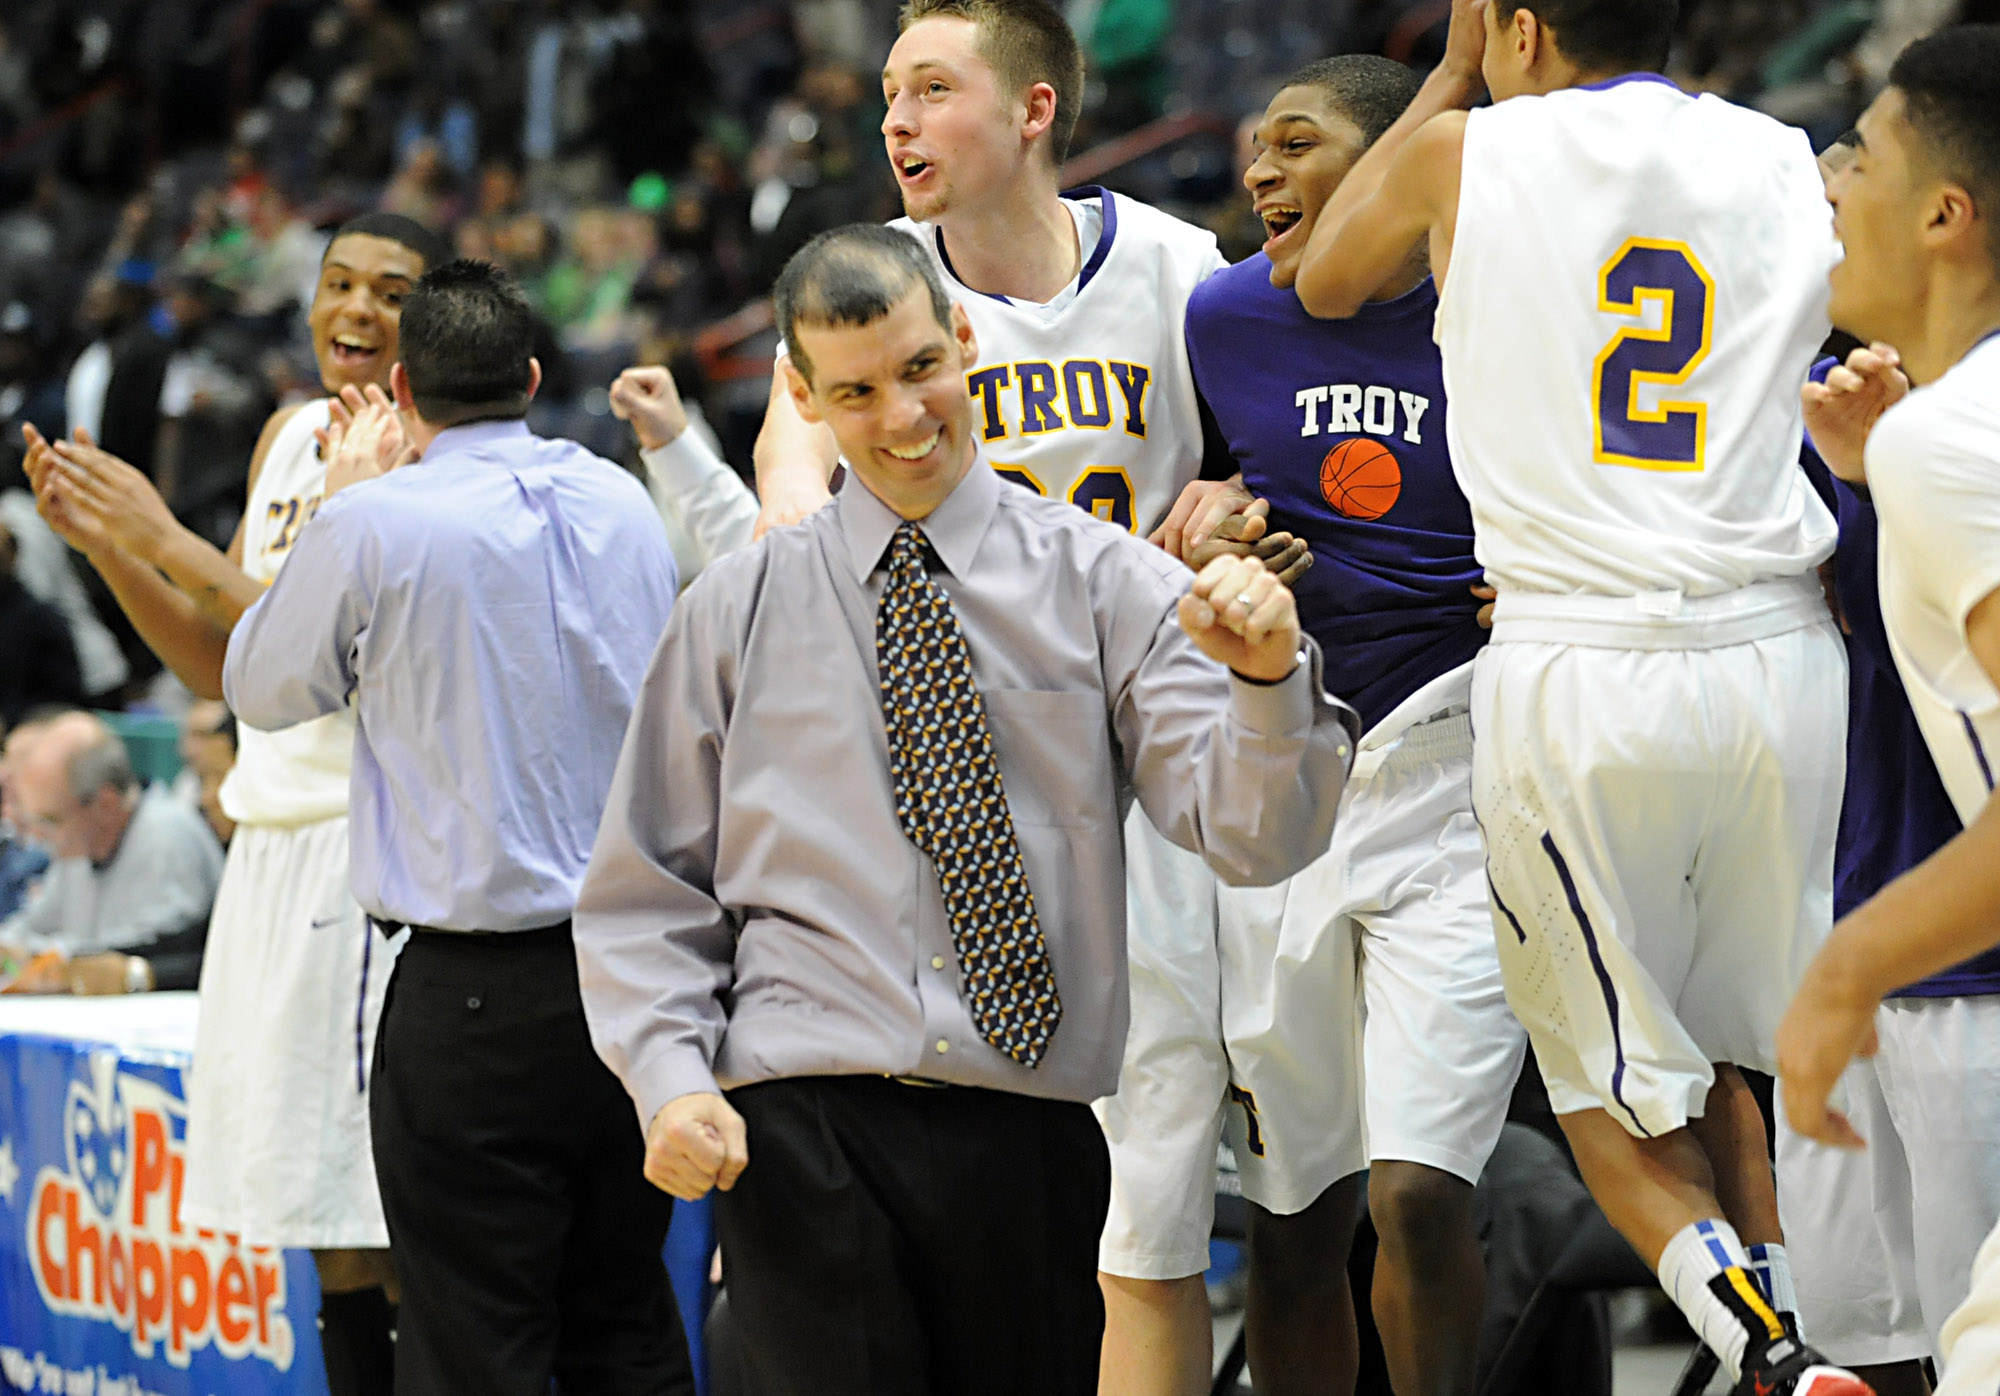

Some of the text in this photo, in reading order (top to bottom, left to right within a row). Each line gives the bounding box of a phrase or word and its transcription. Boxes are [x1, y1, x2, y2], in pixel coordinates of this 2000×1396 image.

[965, 358, 1151, 441] TROY
[1295, 384, 1429, 445] TROY
[1591, 236, 1716, 472] 2
[36, 1180, 280, 1352] Chopper
